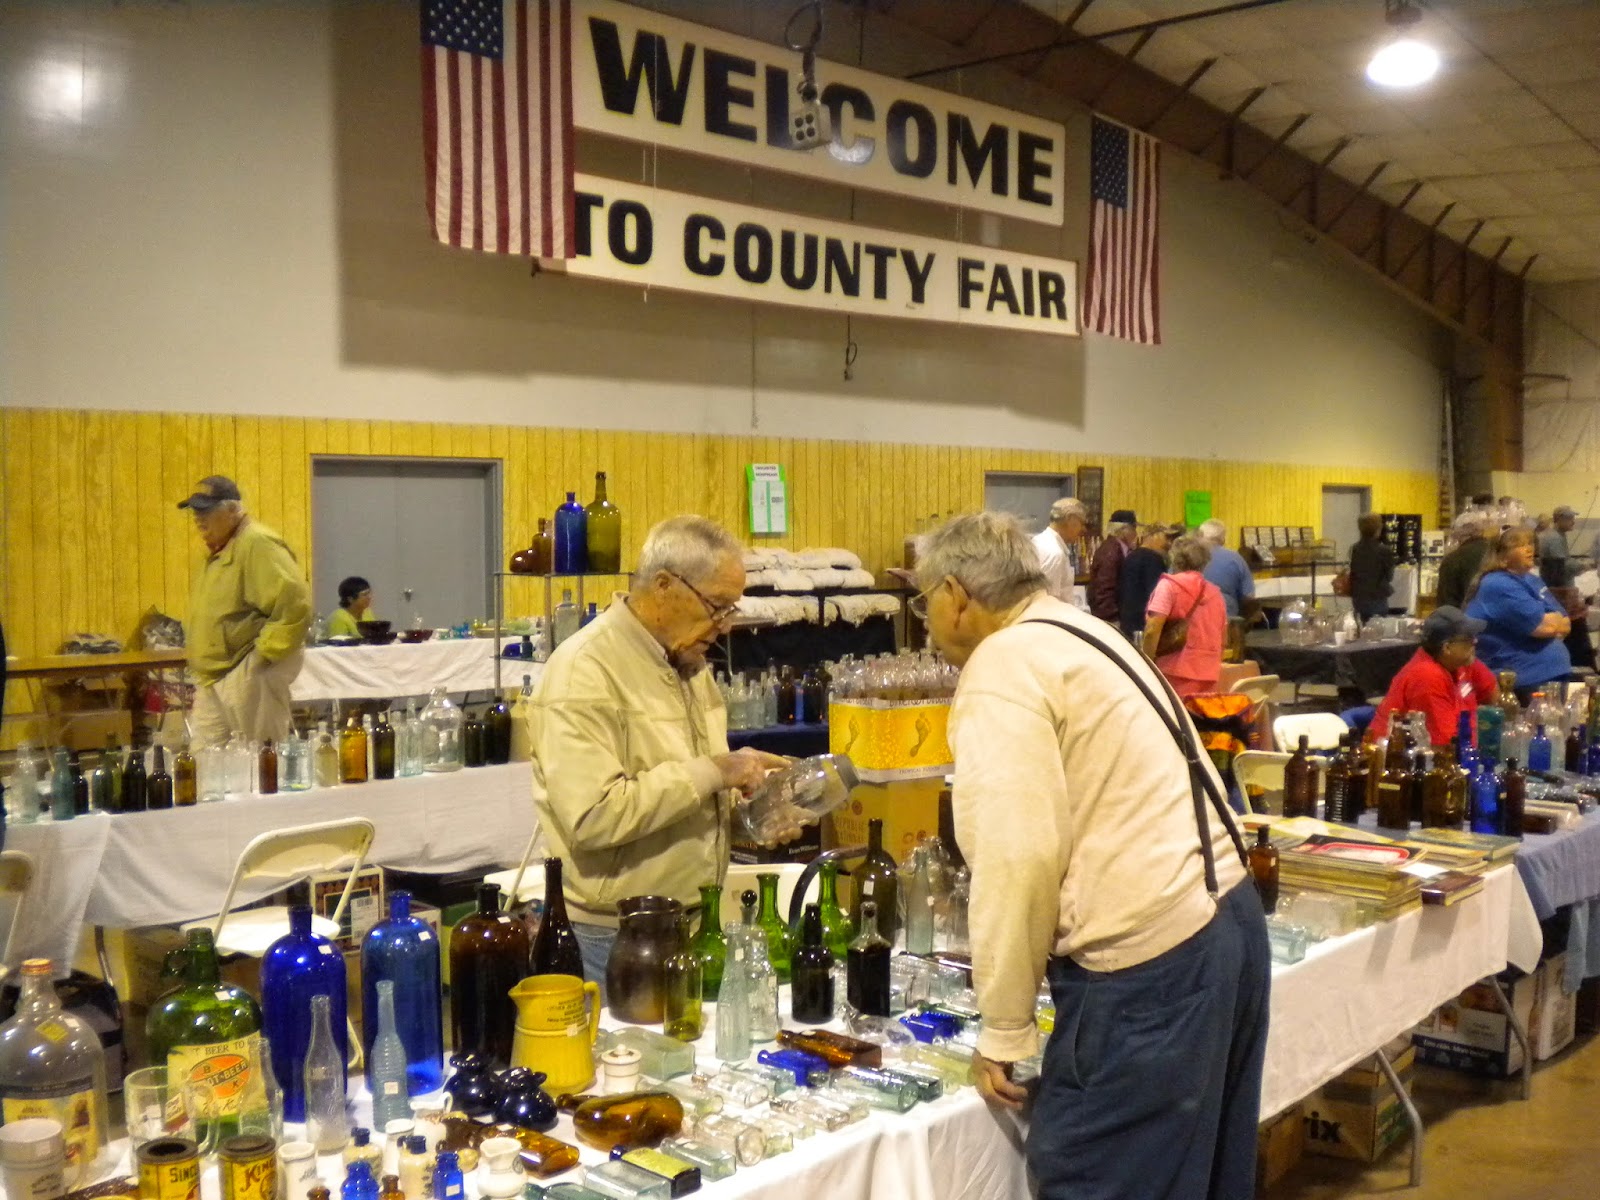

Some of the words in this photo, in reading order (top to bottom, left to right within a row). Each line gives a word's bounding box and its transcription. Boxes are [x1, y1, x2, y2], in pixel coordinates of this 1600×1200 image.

[588, 18, 1053, 206] WELCOME
[575, 191, 653, 265] TO
[684, 212, 936, 304] COUNTY
[958, 257, 1068, 320] FAIR
[205, 1045, 229, 1055] BEER
